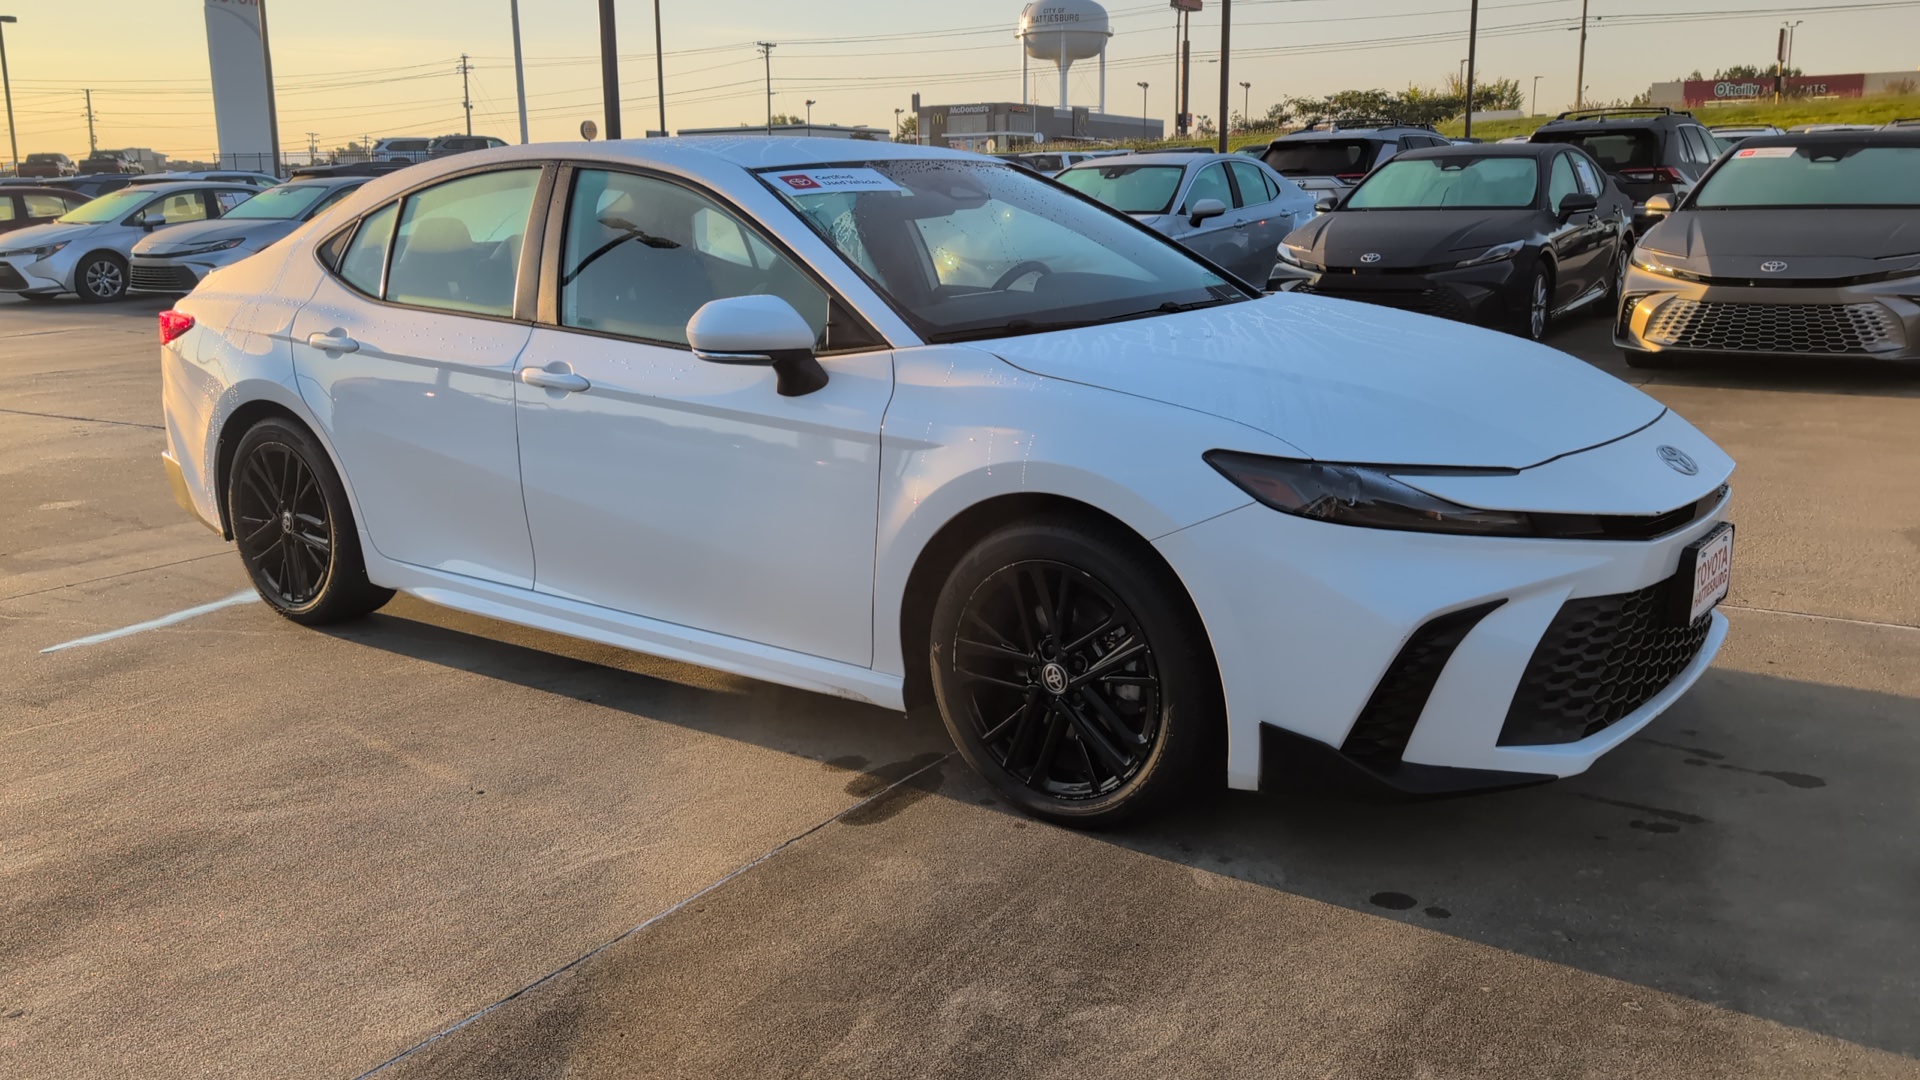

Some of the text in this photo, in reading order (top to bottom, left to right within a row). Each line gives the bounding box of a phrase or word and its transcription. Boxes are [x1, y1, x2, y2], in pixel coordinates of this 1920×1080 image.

[1031, 13, 1080, 23] HATTIESBURG
[1714, 81, 1760, 97] O'Reilly
[949, 105, 990, 114] McDonald's
[1697, 545, 1728, 590] TOYOTA
